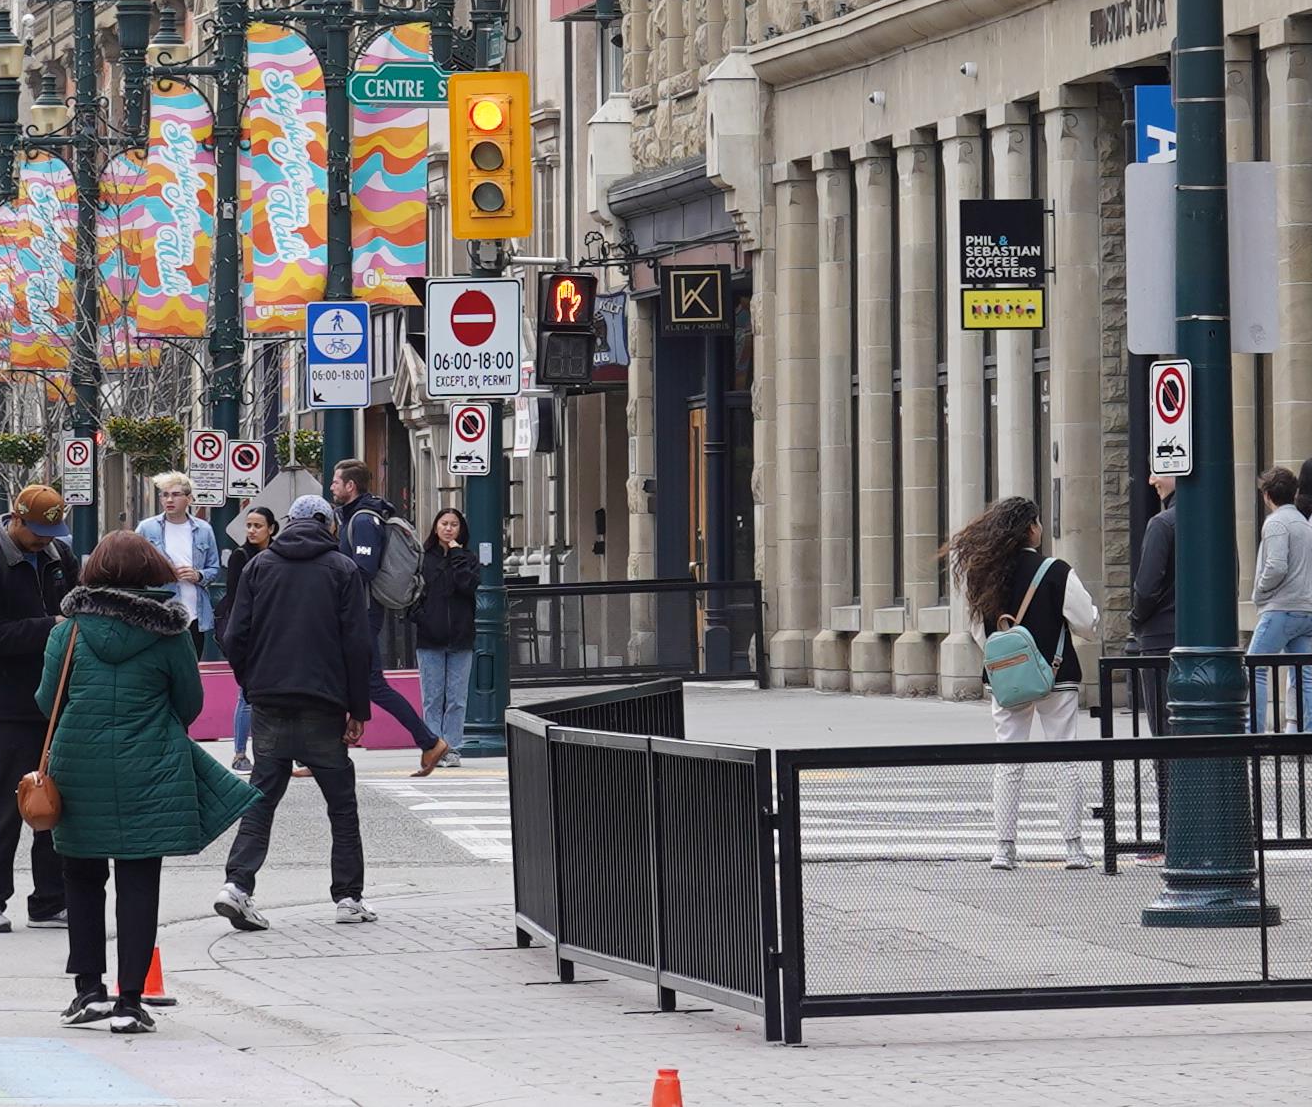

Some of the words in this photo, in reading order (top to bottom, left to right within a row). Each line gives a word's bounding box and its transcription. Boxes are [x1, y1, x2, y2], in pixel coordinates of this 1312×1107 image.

[364, 78, 425, 98] CENTRE
[438, 80, 449, 99] S
[966, 235, 996, 246] PHIL
[998, 235, 1008, 246] &
[965, 246, 1041, 256] SEBASTIAN
[965, 256, 1019, 267] COFFEE
[966, 267, 1037, 278] ROASTERS
[433, 351, 514, 370] 06:00-18:00
[593, 352, 610, 363] UB
[312, 369, 365, 381] 06:00-18:00
[435, 375, 465, 387] EXCEPT
[468, 375, 479, 387] BY
[482, 374, 512, 386] PERMIT
